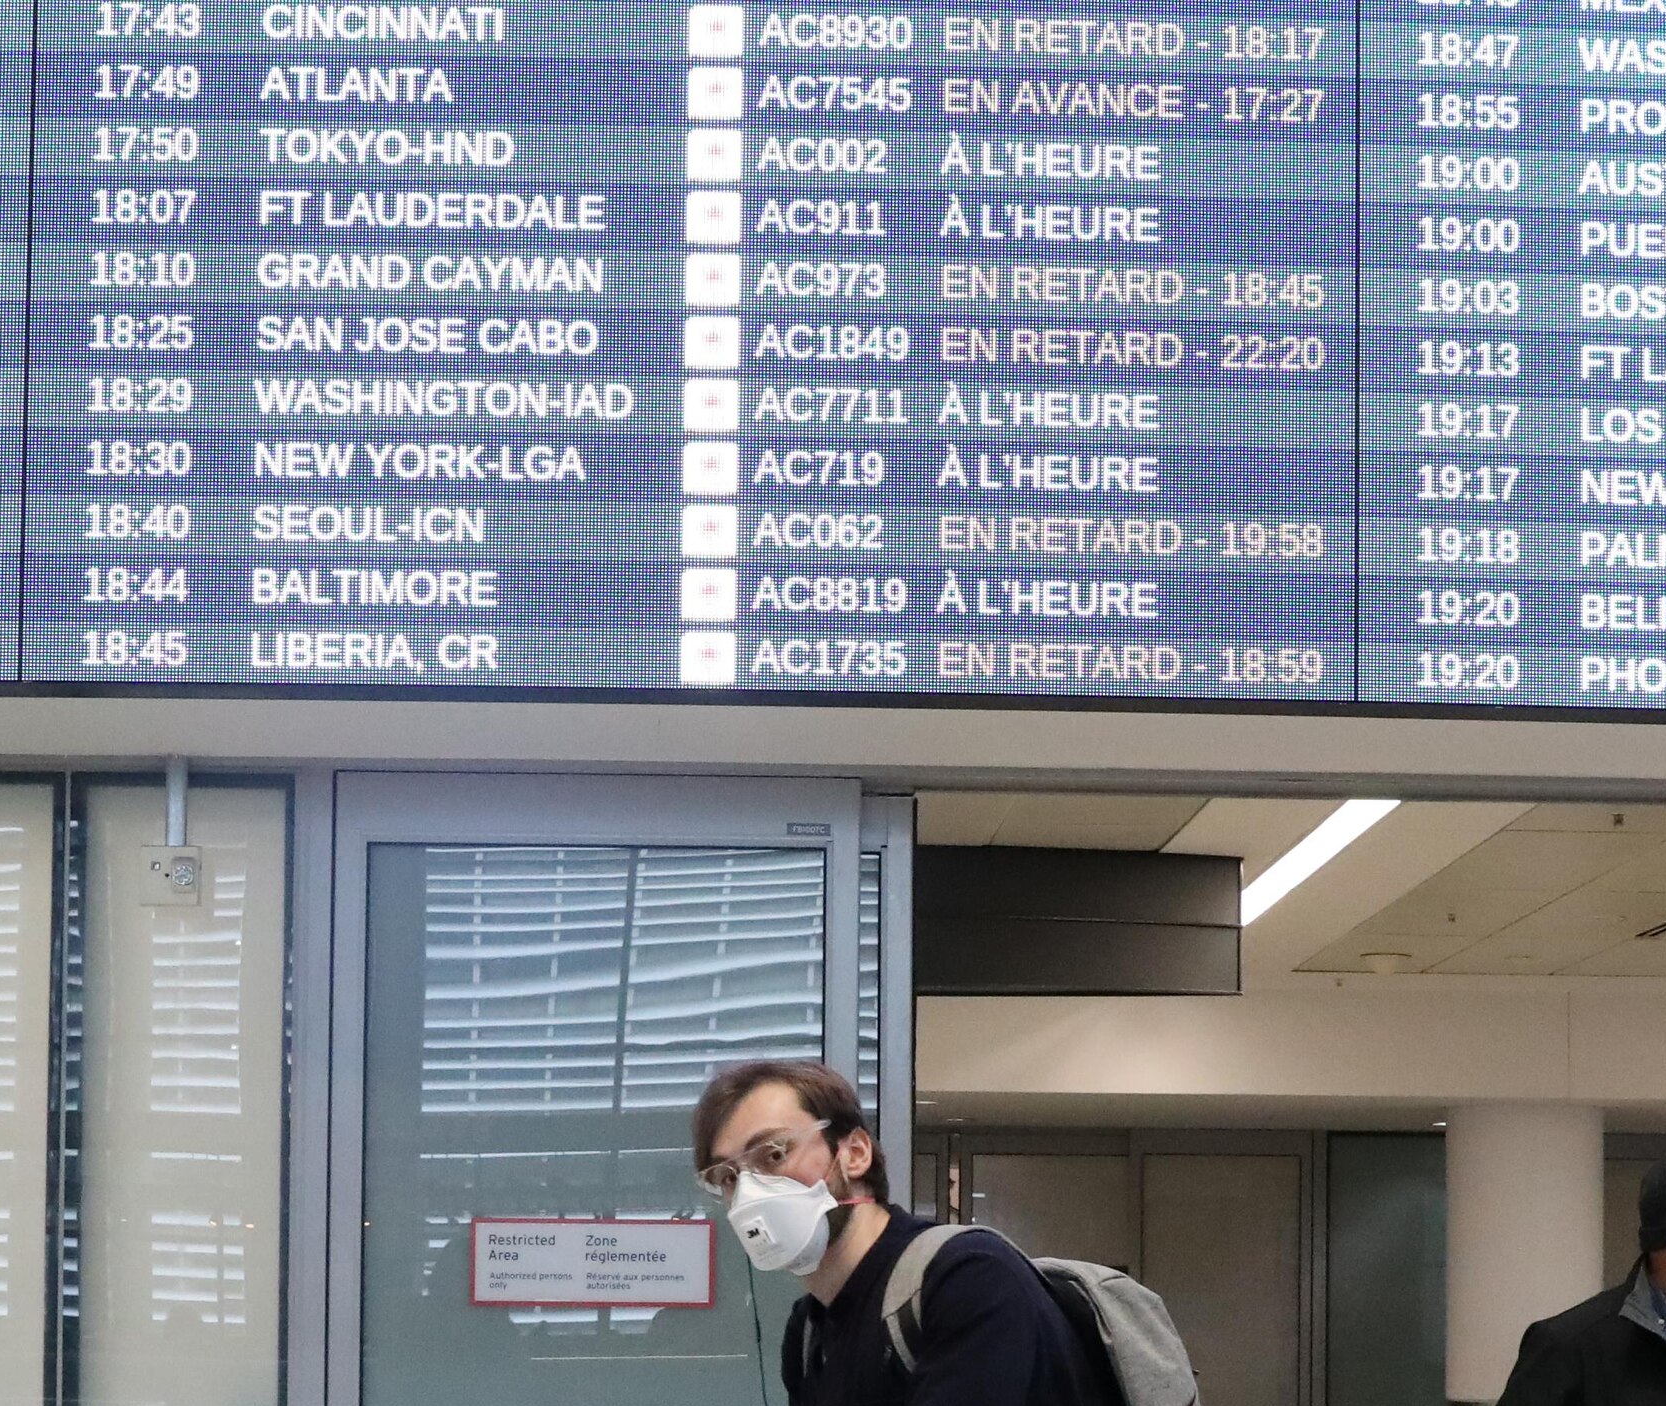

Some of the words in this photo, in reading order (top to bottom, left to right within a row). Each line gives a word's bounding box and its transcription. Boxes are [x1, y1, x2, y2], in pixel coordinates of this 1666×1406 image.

[96, 2, 201, 38] 17:43
[261, 3, 505, 43] CINCINNATI
[759, 12, 913, 51] AC8930
[943, 15, 1001, 52] EN
[1013, 17, 1186, 58] RETARD
[1223, 23, 1327, 62] 18:17
[1418, 31, 1520, 69] 18:47
[93, 125, 199, 162] 17:50
[258, 126, 516, 167] TOKYO-HND
[757, 136, 888, 175] AC002
[940, 131, 972, 176] À
[980, 141, 1161, 182] L'HEURE
[1417, 154, 1520, 192] 19:00
[90, 250, 196, 288] 18:10
[256, 251, 412, 291] GRAND
[422, 254, 604, 294] CAYMAN
[756, 260, 887, 299] AC973
[940, 263, 999, 301] EN
[1011, 265, 1185, 305] RETARD
[1222, 271, 1326, 309] 18:45
[87, 376, 194, 413] 18:29
[253, 378, 635, 420] WASHINGTON-IAD
[754, 386, 909, 425] AC7711
[937, 380, 969, 425] À
[979, 390, 1160, 431] L'HEURE
[1417, 401, 1520, 440] 19:17
[1580, 406, 1663, 445] LOS
[84, 502, 191, 540] 18:40
[252, 503, 486, 544] SEOUL-ICN
[753, 511, 884, 550] AC062
[939, 514, 996, 552] EN
[1009, 515, 1183, 556] RETARD
[1221, 520, 1325, 559] 19:58
[1417, 526, 1520, 565] 19:18
[1415, 652, 1520, 691] 19:20
[487, 1234, 556, 1247] Restricted
[487, 1250, 520, 1262] Area
[585, 1235, 618, 1247] Zone
[585, 1251, 667, 1264] réglementée
[489, 1272, 537, 1281] Authorized
[539, 1273, 573, 1282] persons
[489, 1281, 508, 1291] only
[623, 1274, 638, 1282] aux
[640, 1274, 685, 1283] personnes
